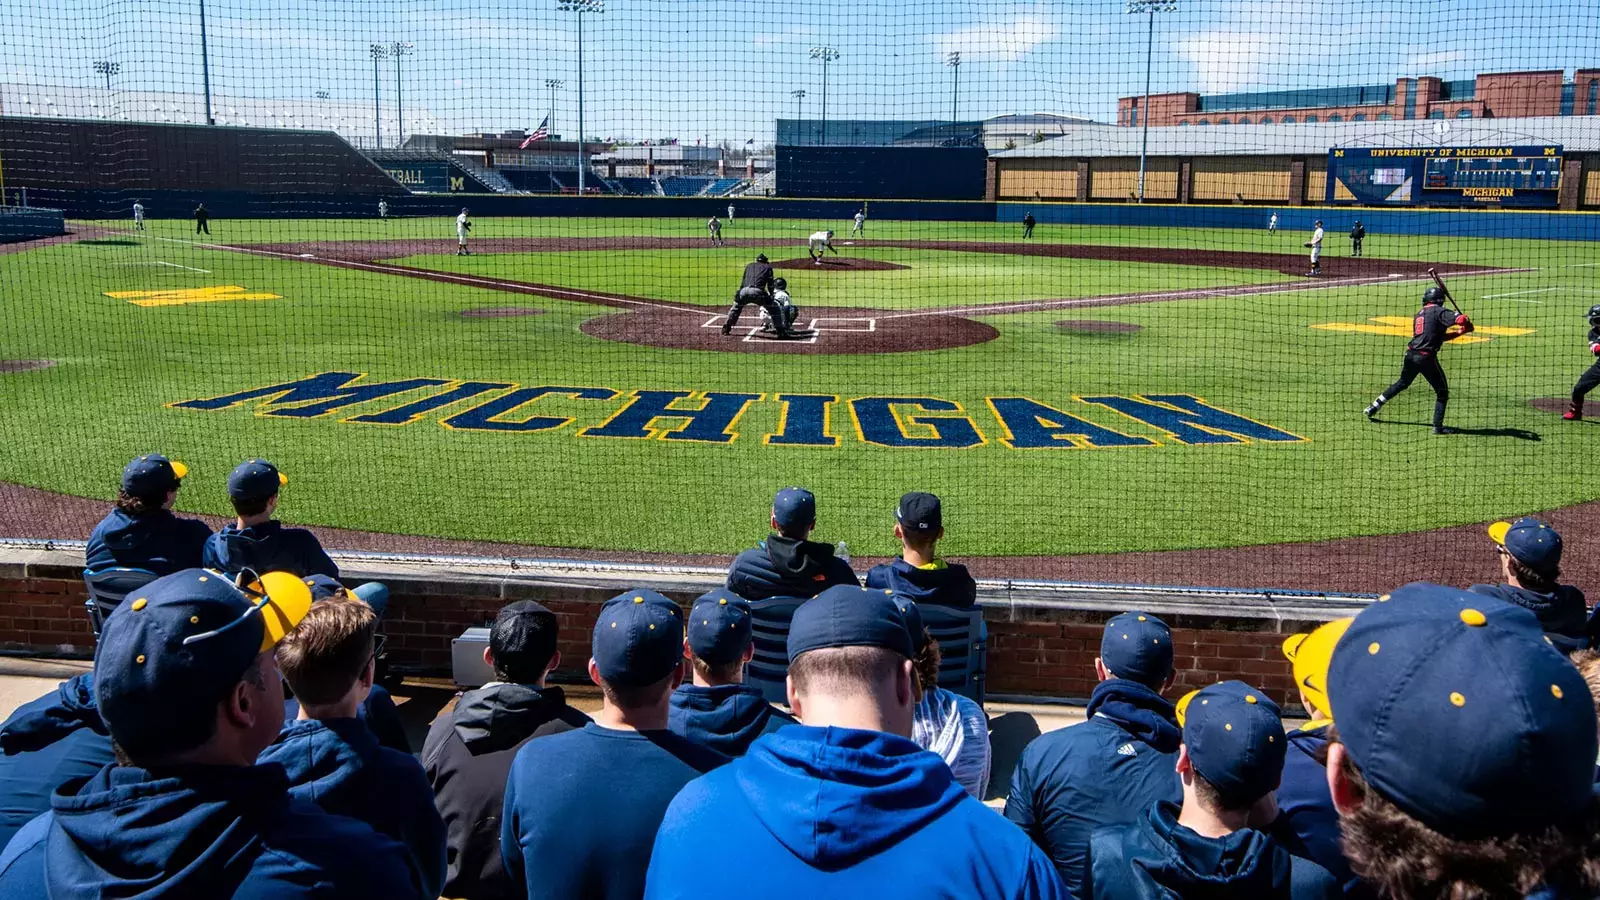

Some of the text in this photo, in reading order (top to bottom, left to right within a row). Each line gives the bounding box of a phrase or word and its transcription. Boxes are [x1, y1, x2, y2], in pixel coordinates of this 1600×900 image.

[1371, 149, 1436, 157] UNIVERSITY
[1456, 148, 1513, 156] MICHIGAN
[450, 177, 464, 190] M
[1462, 188, 1514, 196] MICHIGAN
[166, 371, 1311, 449] MICHIGAN
